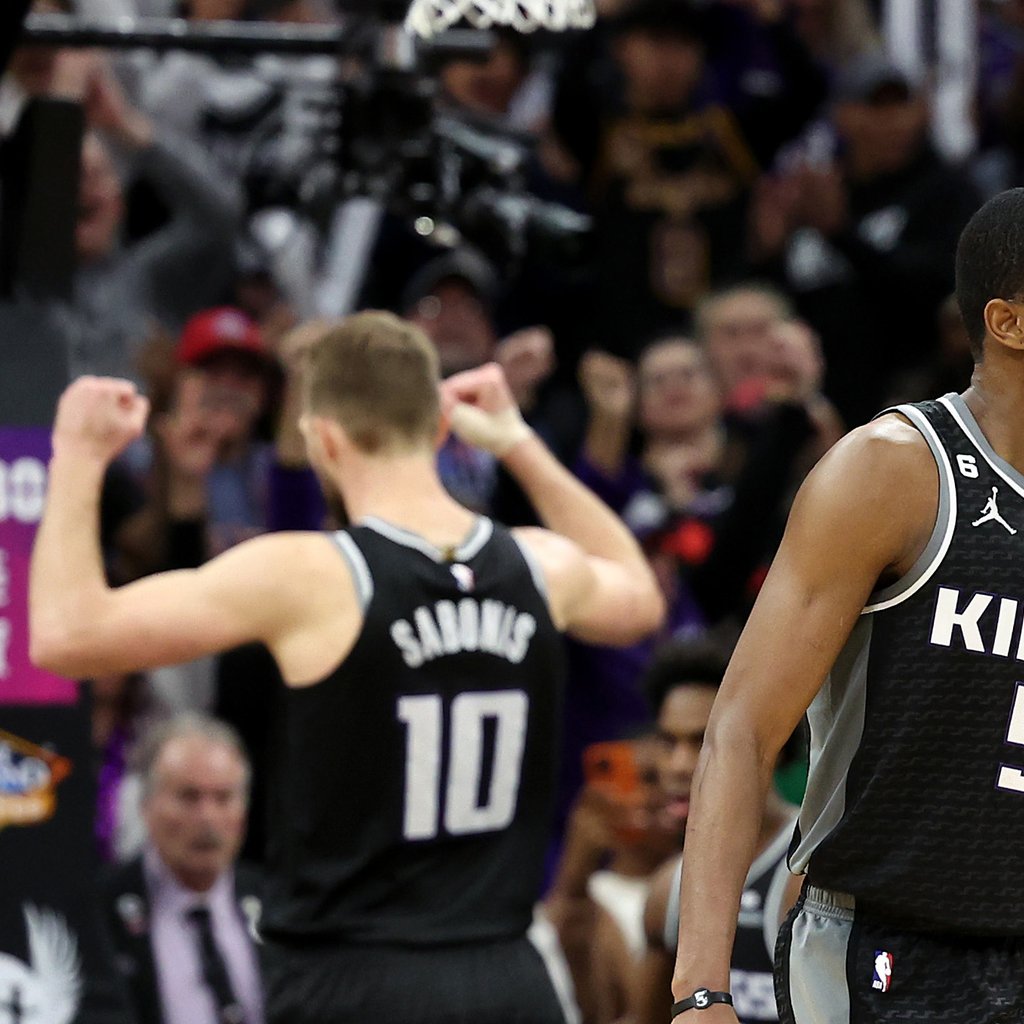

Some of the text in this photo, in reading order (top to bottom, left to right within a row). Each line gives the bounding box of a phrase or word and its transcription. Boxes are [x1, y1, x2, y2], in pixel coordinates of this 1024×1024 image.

[956, 454, 979, 479] 6
[397, 689, 529, 840] 10
[694, 990, 709, 1007] 5
